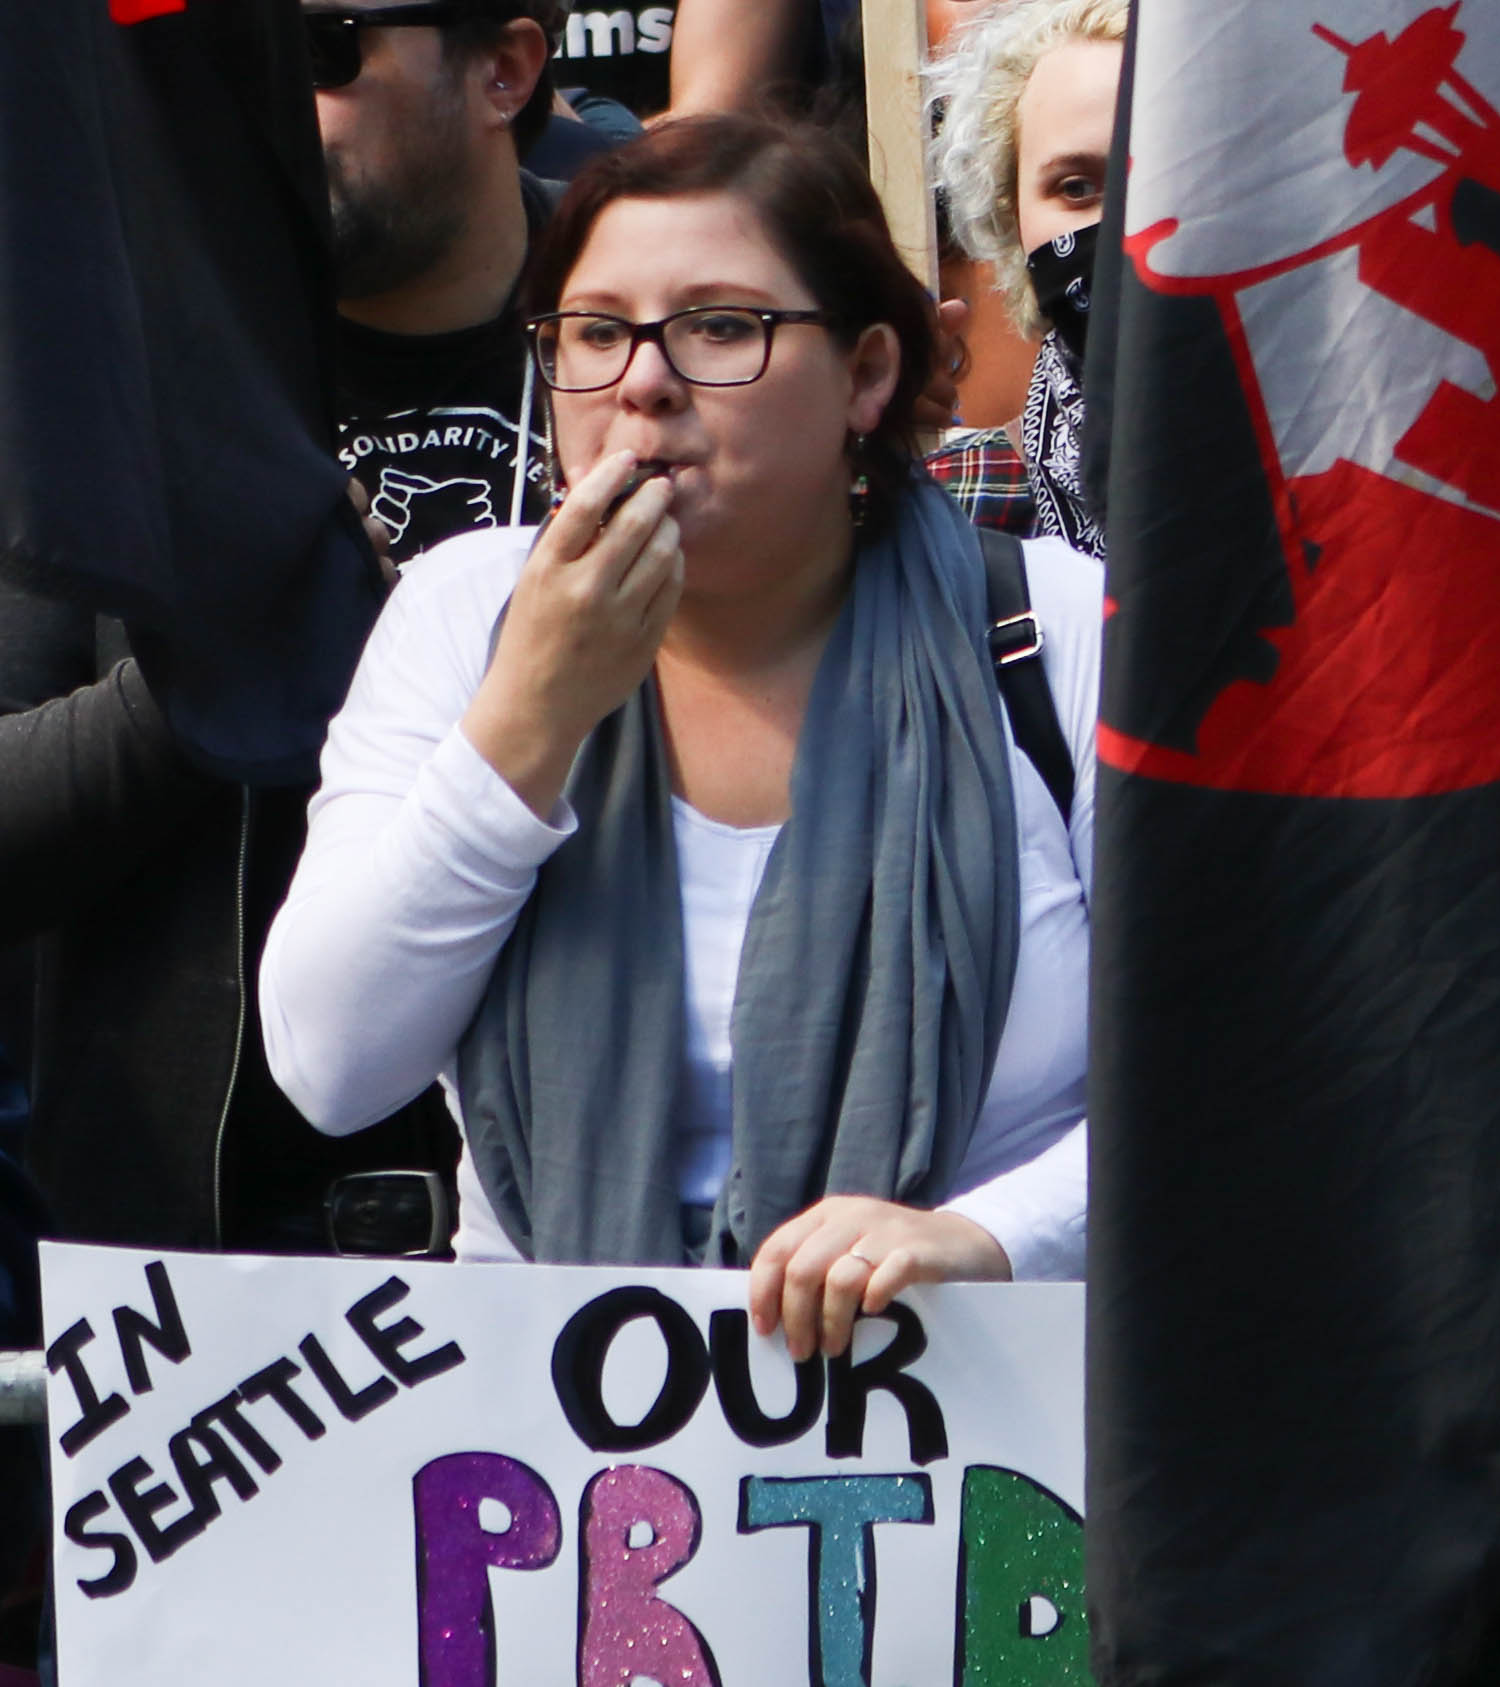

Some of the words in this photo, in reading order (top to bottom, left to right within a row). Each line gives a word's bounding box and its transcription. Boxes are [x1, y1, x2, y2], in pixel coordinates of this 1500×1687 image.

[338, 426, 510, 471] SOLIDARITY
[46, 1260, 192, 1458] IN
[64, 1275, 466, 1600] SEATTLE
[550, 1285, 949, 1464] OUR
